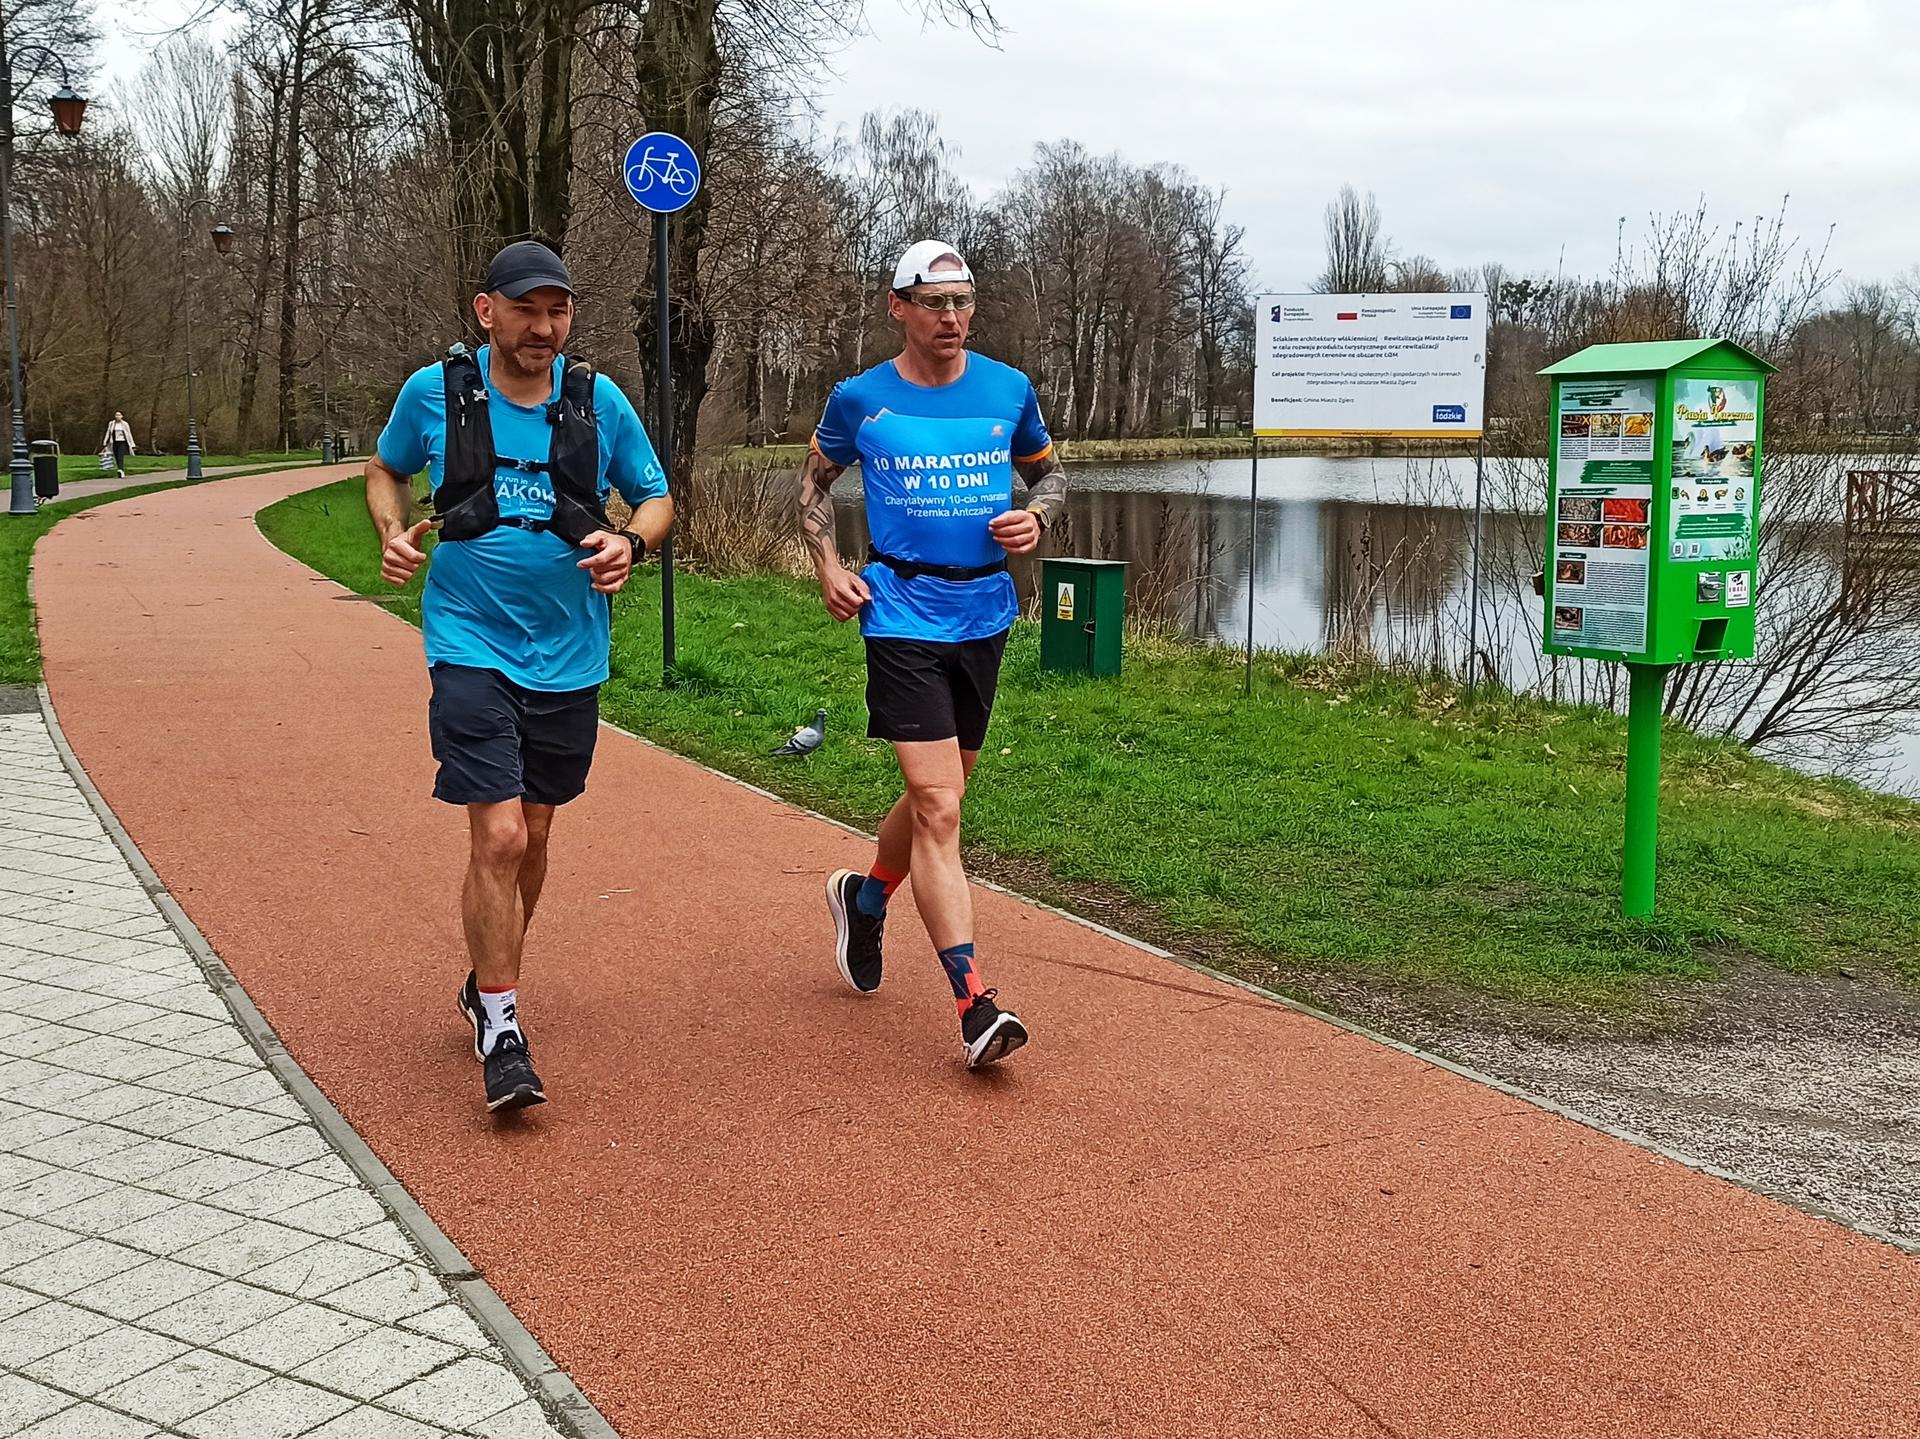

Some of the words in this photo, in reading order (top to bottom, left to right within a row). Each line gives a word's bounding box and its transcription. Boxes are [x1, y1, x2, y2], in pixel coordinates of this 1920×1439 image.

[874, 457, 889, 471] 10
[895, 448, 1009, 471] MARATONÓW
[904, 475, 921, 490] W
[928, 475, 950, 489] 10
[957, 472, 989, 488] DNI
[885, 495, 946, 508] Charytatywny
[949, 495, 978, 504] 10-cio
[907, 508, 950, 518] Przemka
[952, 506, 993, 517] Antczaka
